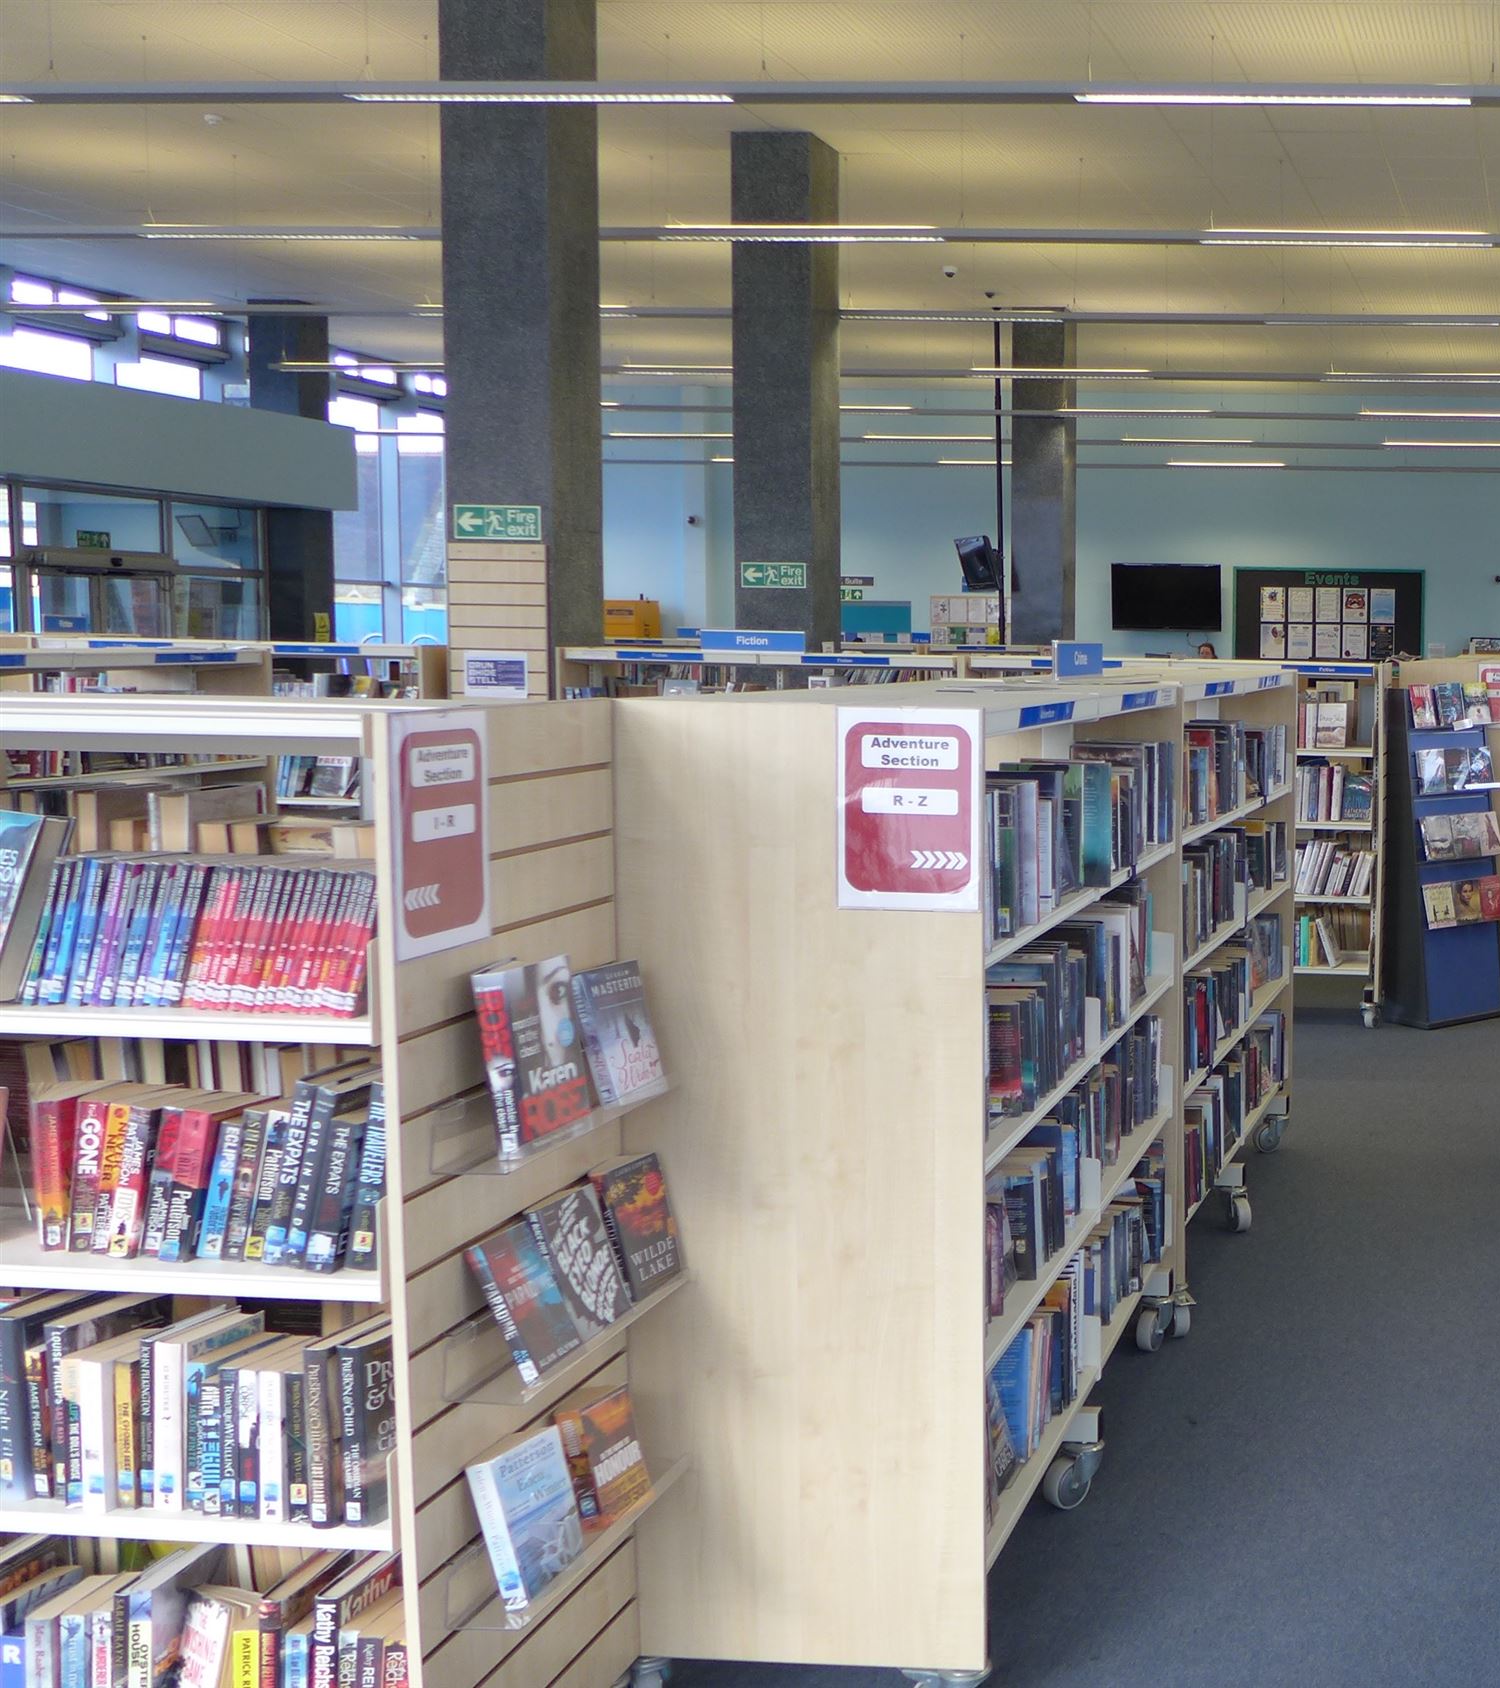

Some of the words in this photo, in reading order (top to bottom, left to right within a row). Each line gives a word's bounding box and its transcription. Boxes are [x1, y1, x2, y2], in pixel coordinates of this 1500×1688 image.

[506, 509, 536, 523] Fire
[506, 523, 537, 536] exit
[780, 565, 802, 576] Fire
[780, 575, 803, 586] exit
[1304, 571, 1360, 586] Events
[736, 635, 769, 646] Fiction
[1073, 651, 1089, 666] Crime
[416, 748, 469, 763] Adventure
[870, 737, 950, 751] Adventure
[423, 767, 463, 783] Section
[881, 754, 939, 767] Section
[893, 795, 903, 806] R
[918, 796, 928, 807] Z
[528, 1061, 579, 1096] Karen
[290, 1099, 312, 1127] THE
[77, 1117, 101, 1176] GONE
[218, 1126, 241, 1176] ECLIPSE
[333, 1126, 350, 1150] THE
[101, 1133, 117, 1182] NEVER
[119, 1121, 138, 1187] PATTERSON
[279, 1127, 306, 1186] EXPATS
[258, 1148, 283, 1201] Patterson
[301, 1161, 314, 1177] IN
[324, 1150, 346, 1196] EXPATS
[145, 1186, 164, 1233] PATTERSO
[295, 1183, 311, 1211] THE
[630, 1235, 676, 1268] WILDE
[638, 1253, 676, 1282] LAKE
[482, 1281, 519, 1341] PARADIME
[51, 1330, 63, 1363] LOUISE
[140, 1345, 152, 1369] JOHN
[29, 1381, 40, 1410] JAMES
[52, 1365, 64, 1405] PHILLIPS
[30, 1411, 43, 1447] PHELAN
[312, 1603, 336, 1643] Kathy
[131, 1623, 141, 1668] HOUSE
[241, 1637, 252, 1677] PATRICK
